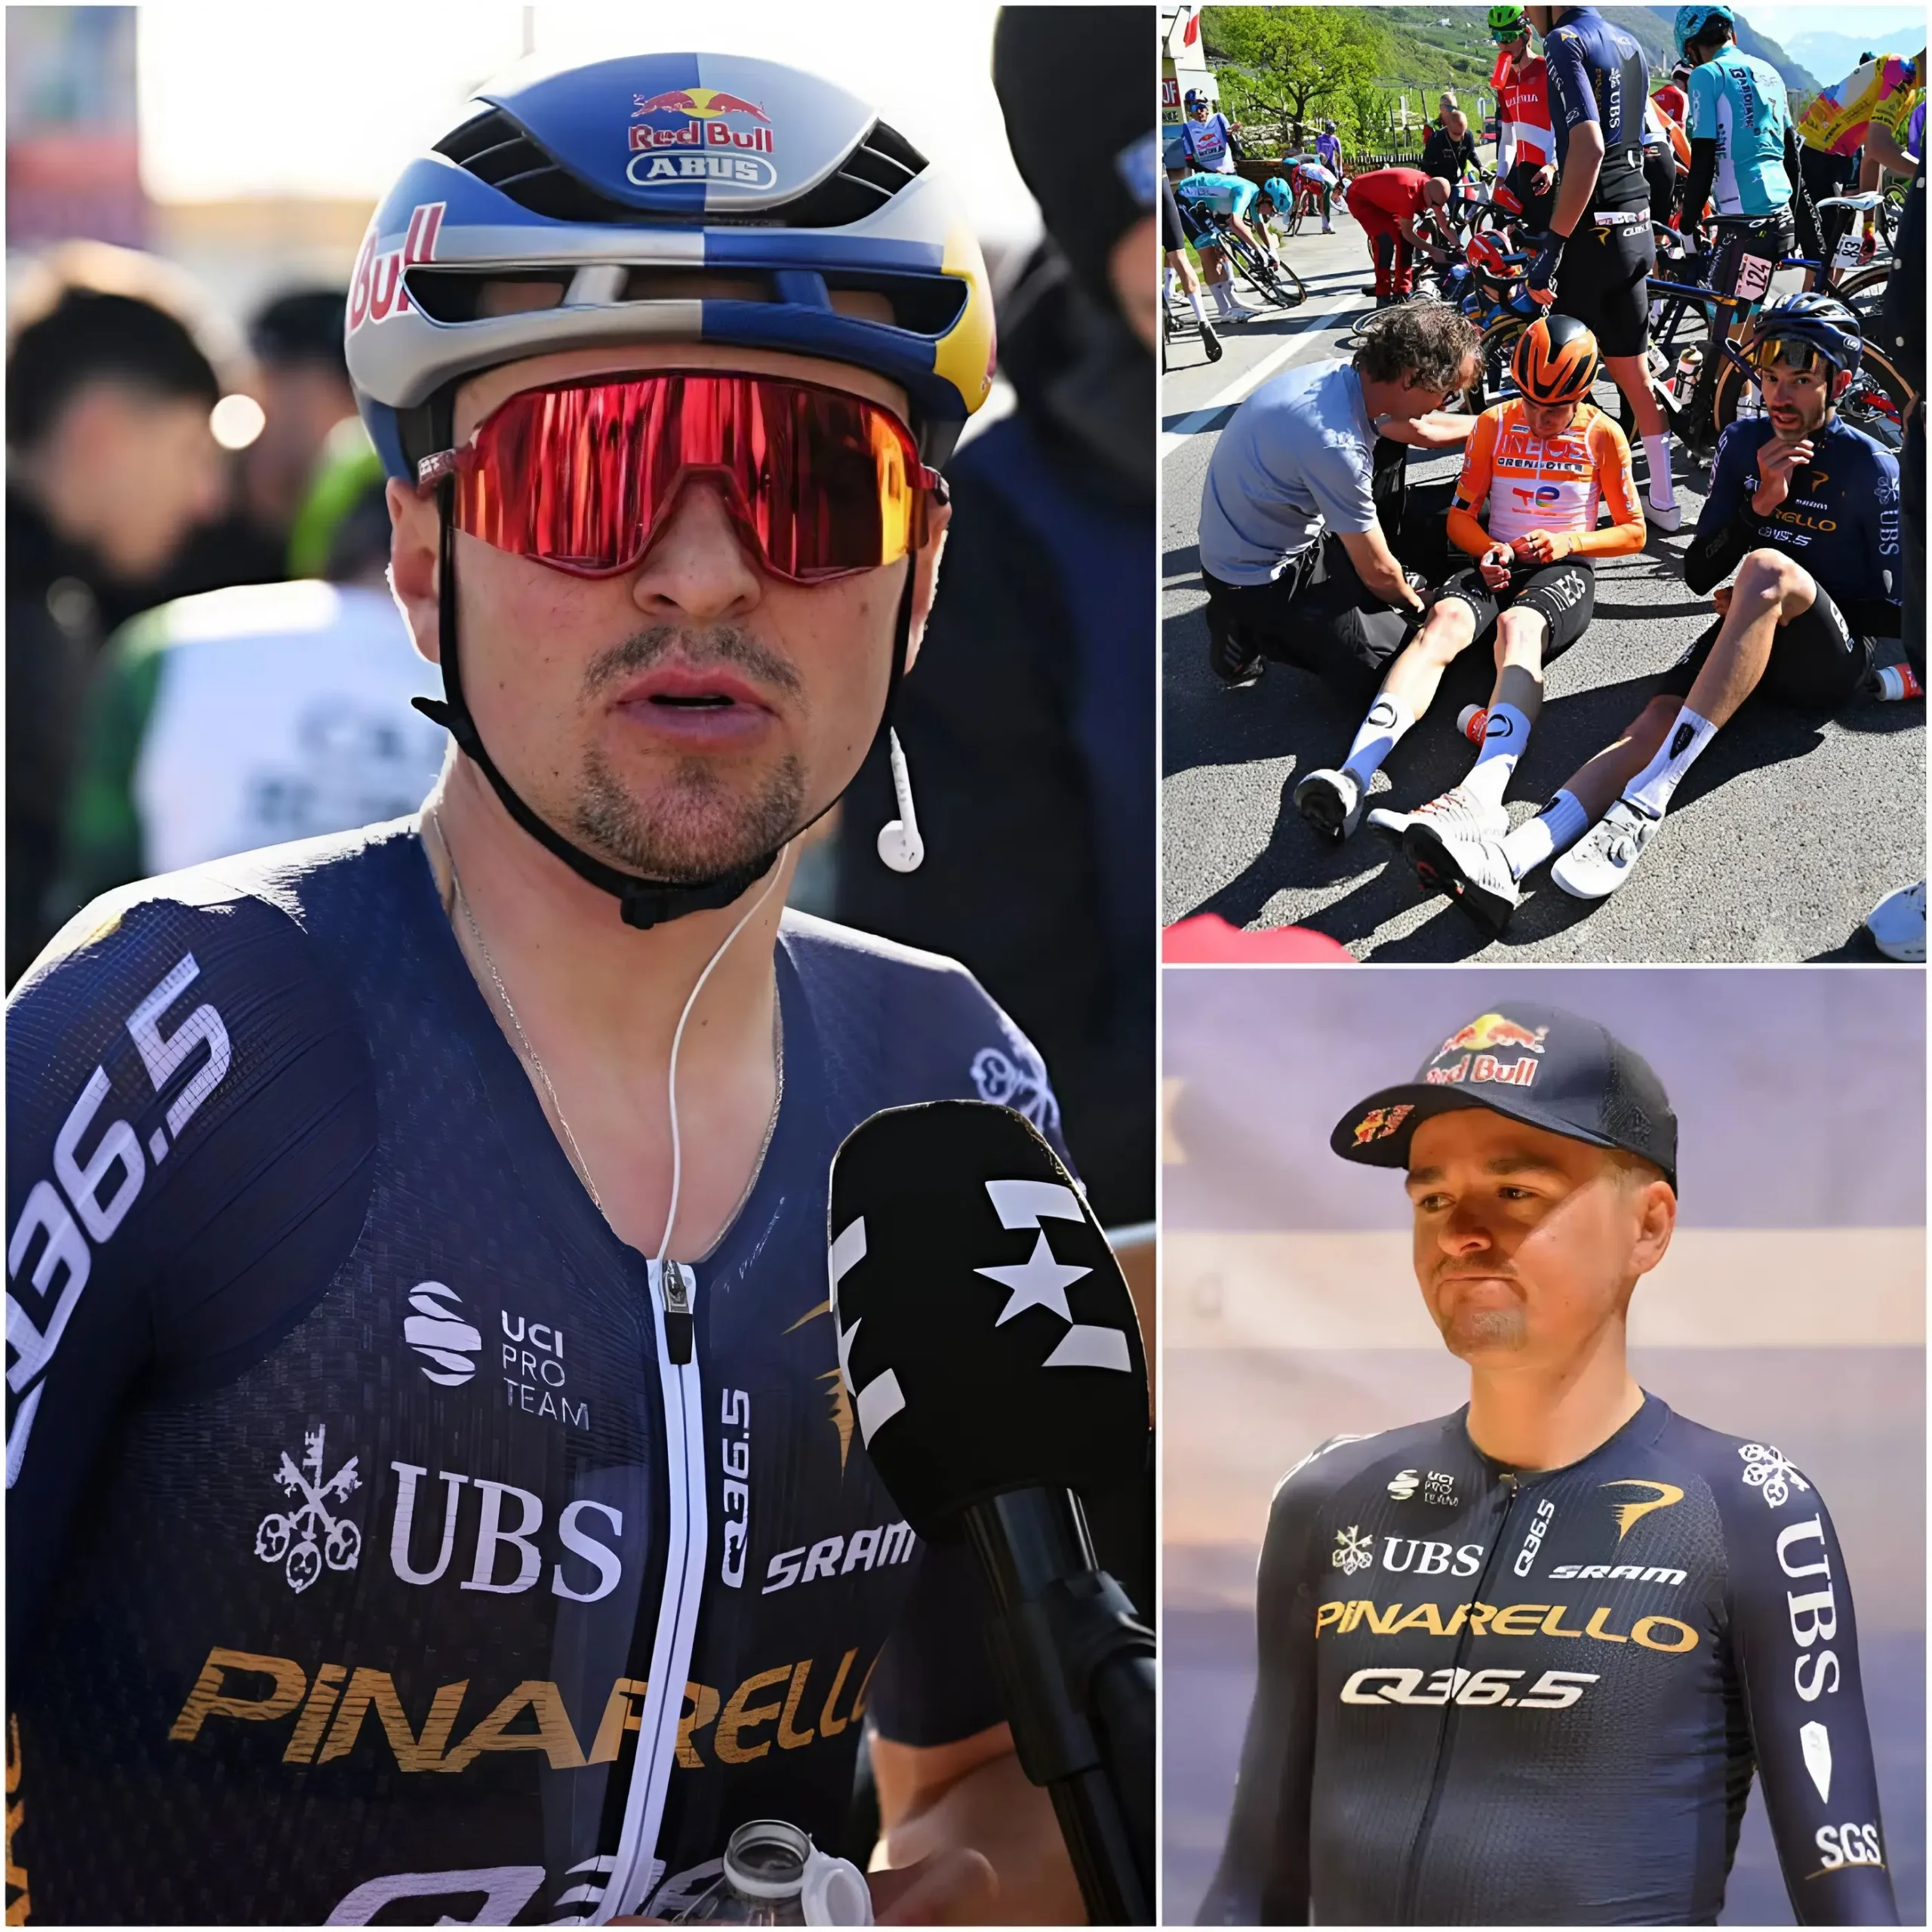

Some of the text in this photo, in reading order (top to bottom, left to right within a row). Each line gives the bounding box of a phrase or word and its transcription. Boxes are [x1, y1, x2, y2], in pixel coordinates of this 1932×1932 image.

[629, 121, 774, 152] Red Bull
[647, 158, 758, 182] ABUS
[346, 202, 446, 334] Bull
[1841, 242, 1860, 258] 83
[1746, 262, 1770, 292] 124
[1879, 509, 1899, 555] UBS
[1471, 1054, 1538, 1087] Bull
[502, 1310, 563, 1358] UCI
[503, 1343, 565, 1387] PRO
[503, 1377, 589, 1430] TEAM
[721, 1388, 750, 1588] Q36.5
[390, 1461, 623, 1602] UBS
[1514, 1500, 1555, 1577] Q36.5
[761, 1519, 916, 1595] SRAM
[1383, 1537, 1484, 1577] UBS
[1549, 1564, 1687, 1585] SRAM
[1315, 1600, 1699, 1652] PINARELLO
[1777, 1512, 1840, 1702] UBS
[168, 1639, 889, 1772] PINARELL
[1341, 1667, 1600, 1709] Q36.5
[1816, 1823, 1881, 1869] SGS
